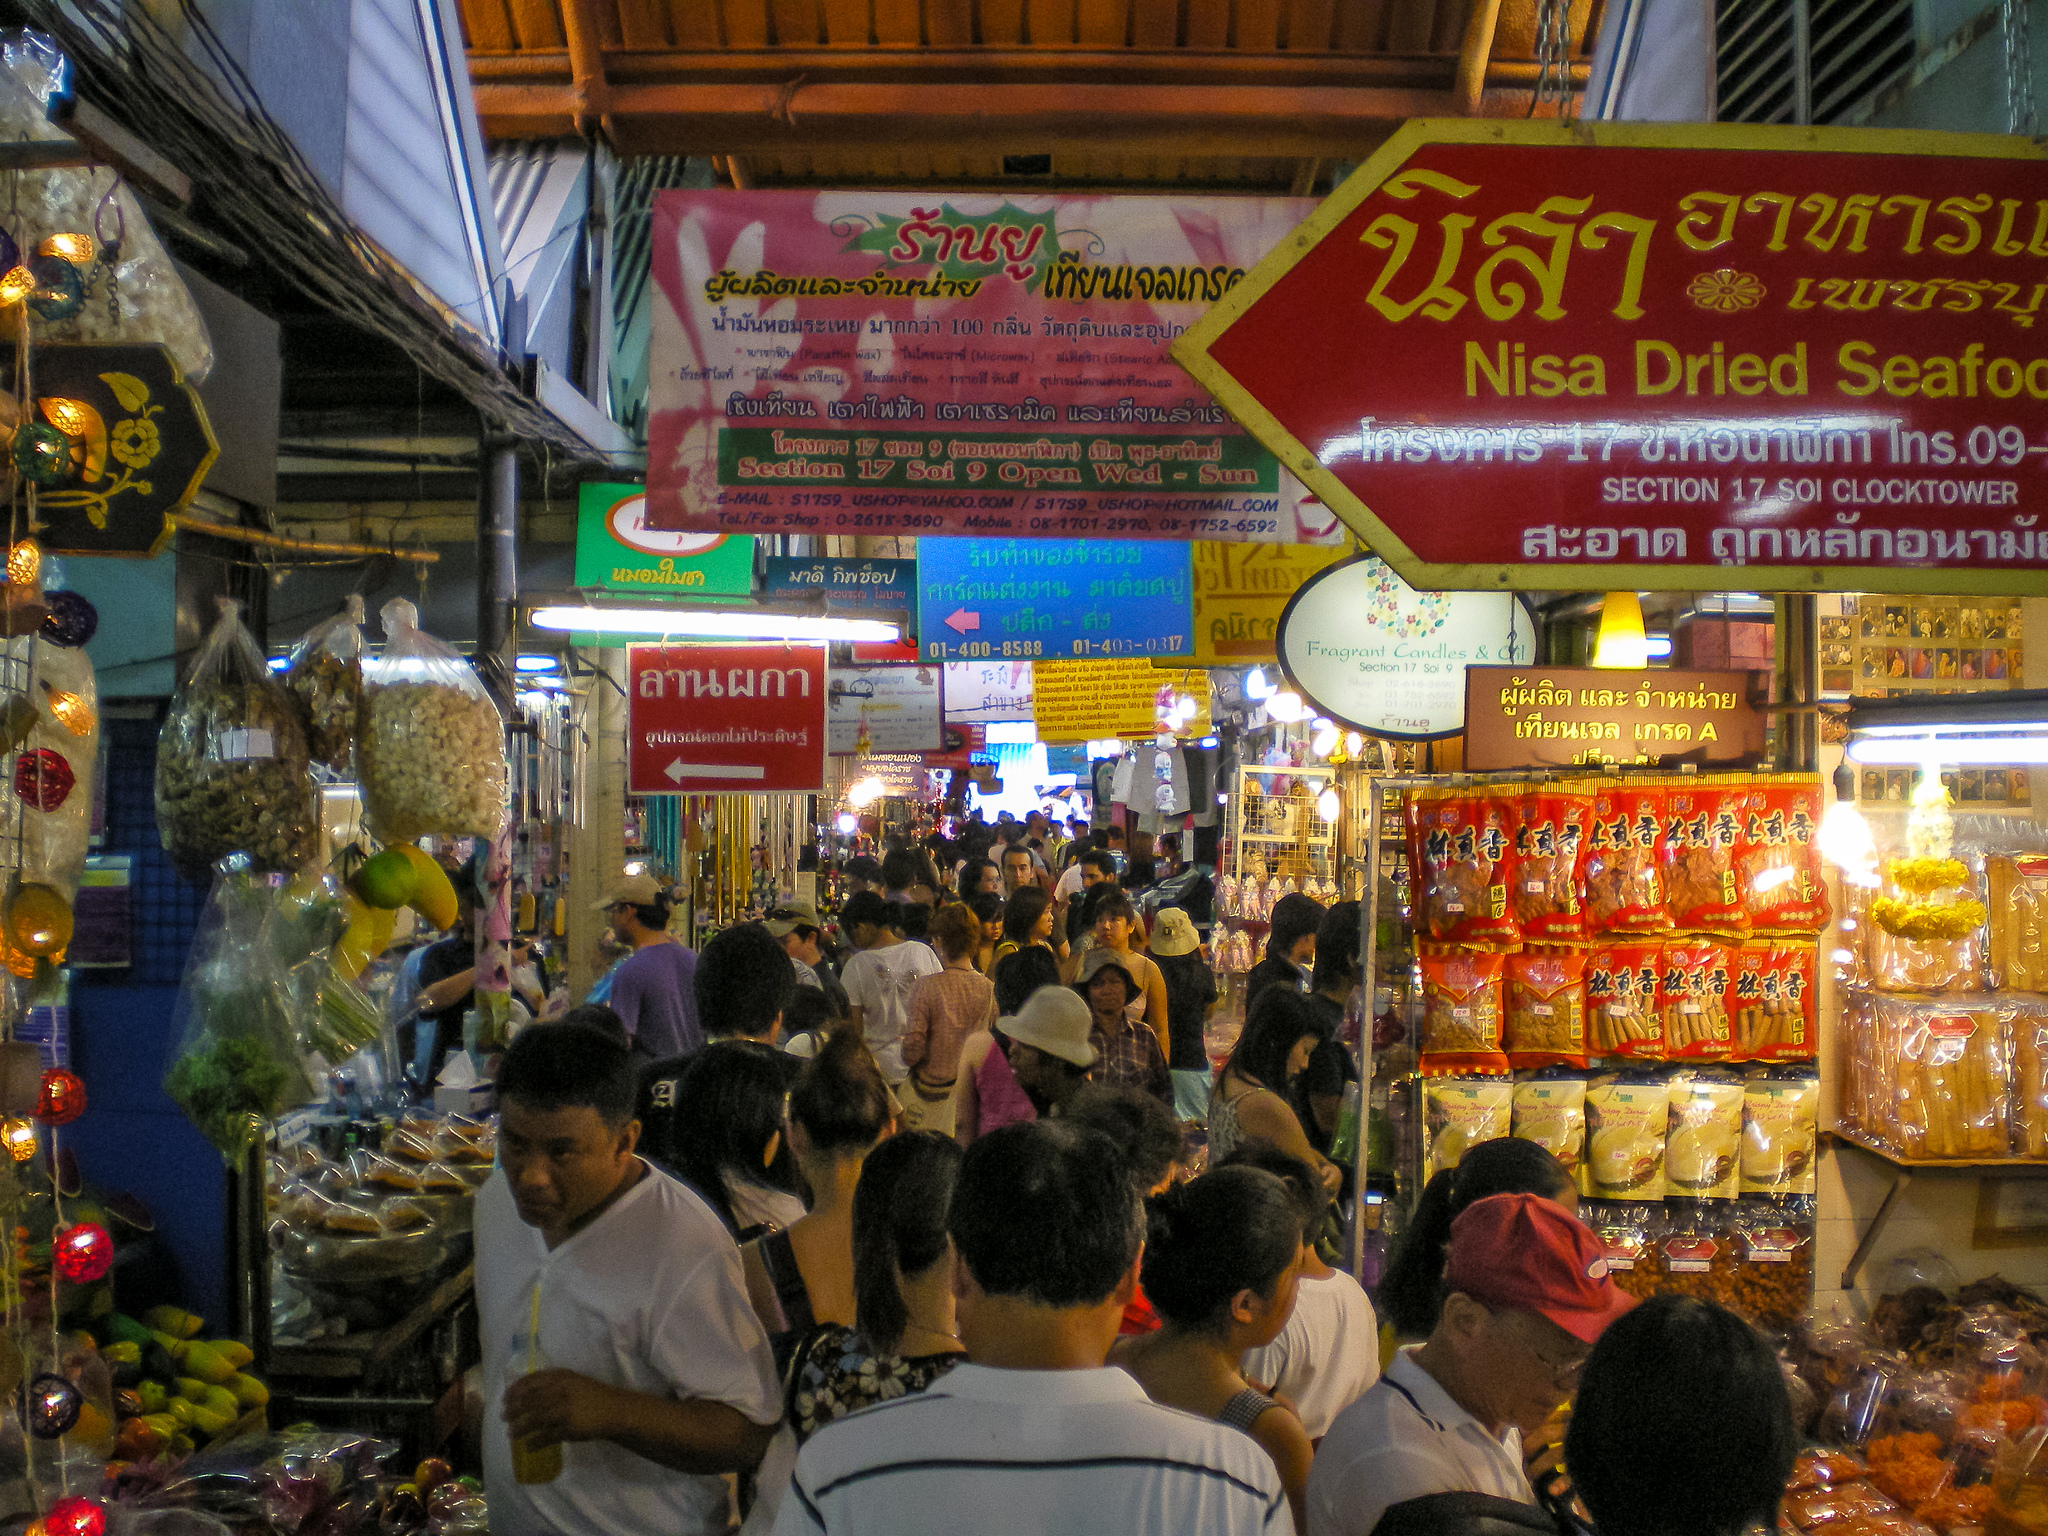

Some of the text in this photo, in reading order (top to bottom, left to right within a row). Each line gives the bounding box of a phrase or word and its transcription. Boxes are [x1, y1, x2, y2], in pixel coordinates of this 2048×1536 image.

[890, 206, 1046, 282] ร้านยู
[1359, 168, 1657, 323] นิสา
[704, 269, 982, 303] ผู้ผลิตและจำหน่าย
[711, 306, 861, 334] น้ำมันหอมระเหย
[869, 315, 941, 335] มากกว่า
[951, 317, 983, 336] 100
[991, 311, 1031, 337] กลิ่น
[1465, 340, 2048, 398] Nisa Dried Seafoo
[725, 390, 817, 418] เชิงเทียน
[855, 437, 880, 456] 17
[928, 439, 943, 458] 9
[1565, 421, 1618, 463] 17
[1888, 417, 2048, 466] โทร.09-
[737, 456, 846, 479] Section
[857, 458, 896, 480] 17
[906, 460, 956, 482] Soi
[966, 461, 987, 482] 9
[998, 462, 1082, 488] Open
[1092, 463, 1163, 484] Wed
[1199, 463, 1259, 484] Sun
[717, 491, 773, 507] E-MAIL
[1601, 477, 2018, 505] SECTION 17 SOI CLOCKTOWER
[783, 512, 819, 529] Shop
[963, 514, 1012, 530] Mobile
[1523, 523, 1687, 559] สะอาด
[788, 564, 826, 584] มาดี
[929, 639, 1043, 658] 01-400-8588
[1306, 640, 1385, 663] Fragrant
[1393, 642, 1467, 660] Candles
[1475, 644, 1490, 660] &
[639, 668, 810, 698] ลานผกา
[1359, 662, 1453, 674] Section 17 Soi 9
[1501, 676, 1737, 716] ผู้ผลิต และ จำหน่าย
[1514, 711, 1718, 742] เทียนเจล เกรด A
